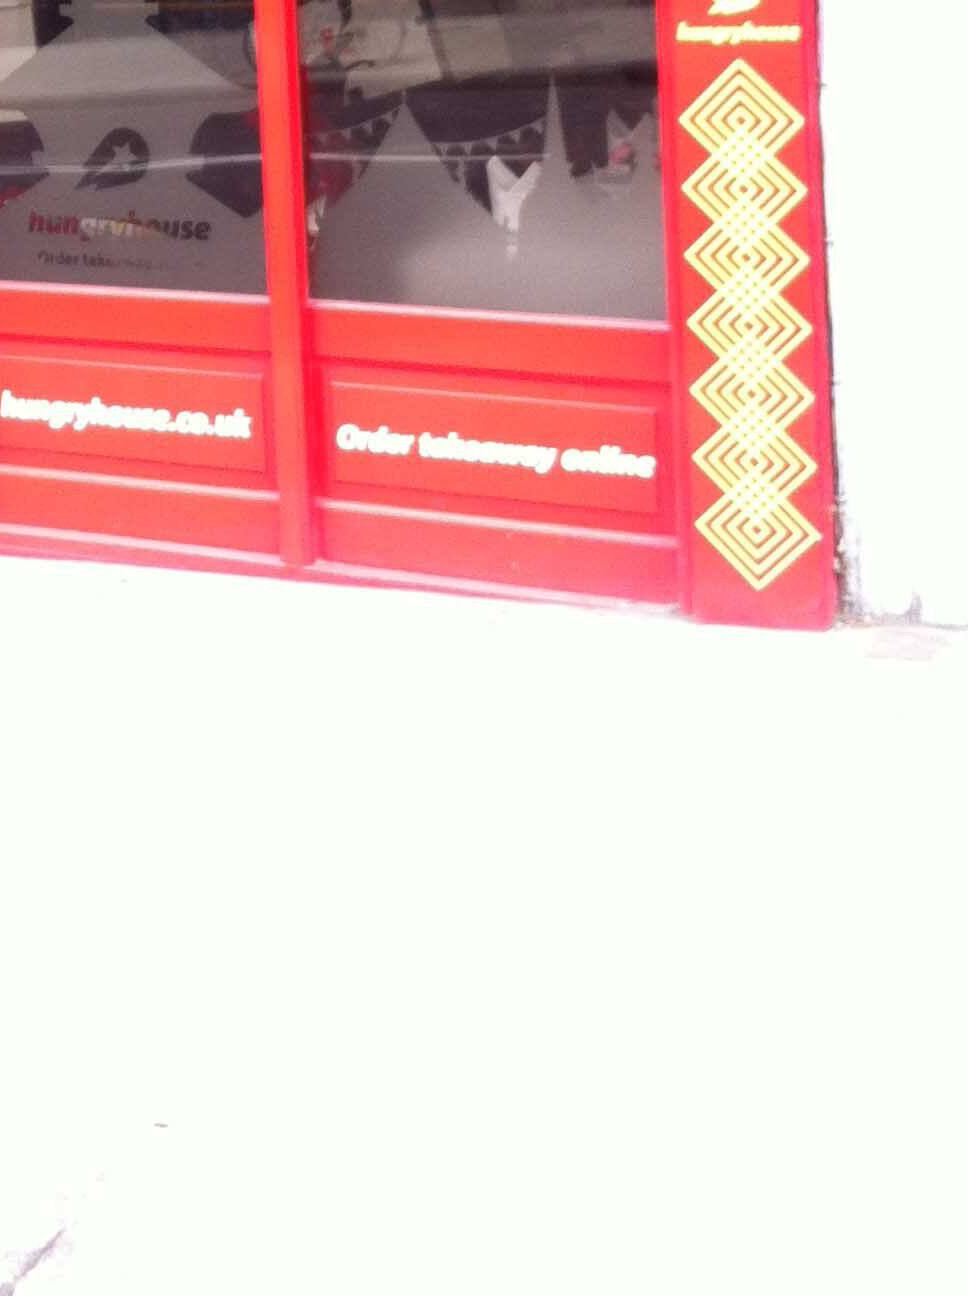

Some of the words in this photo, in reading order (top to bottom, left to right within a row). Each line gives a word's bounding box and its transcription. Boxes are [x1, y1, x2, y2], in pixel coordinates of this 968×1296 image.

[0, 389, 252, 439] hungryhouse.co.uk
[336, 423, 414, 454] Order
[418, 432, 558, 474] takeaway
[560, 444, 657, 479] online
